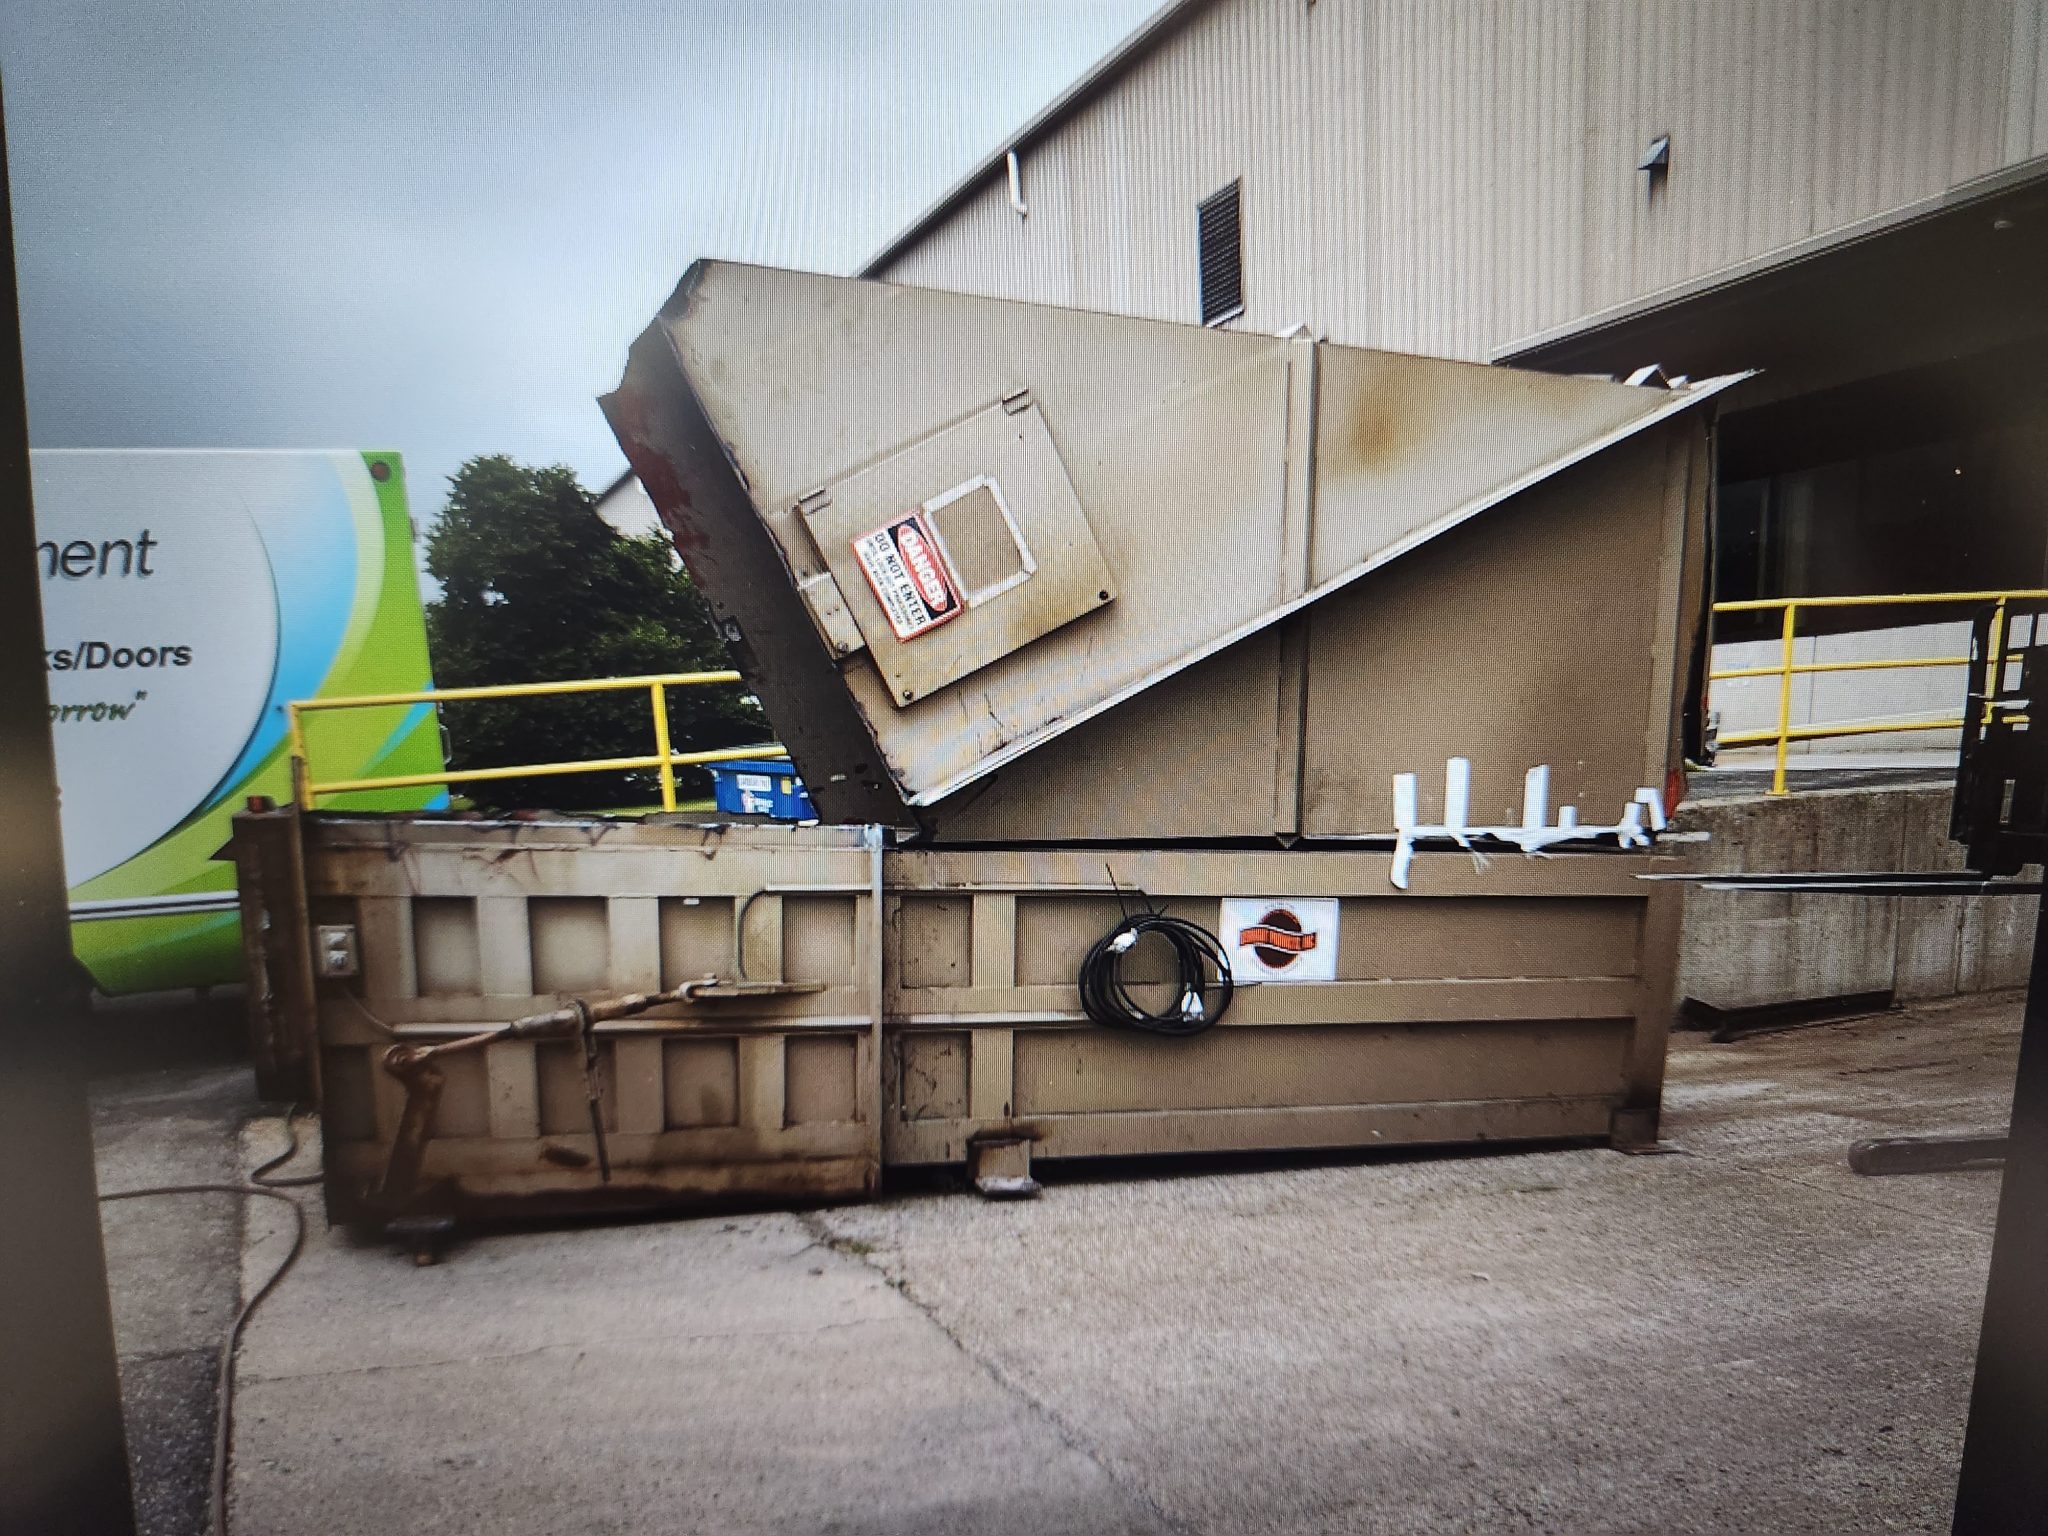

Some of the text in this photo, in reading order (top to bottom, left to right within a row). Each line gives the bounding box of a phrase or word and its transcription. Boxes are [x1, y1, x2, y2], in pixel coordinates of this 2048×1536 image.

[874, 532, 927, 625] DO NOT ENTER
[899, 531, 947, 606] DANGER
